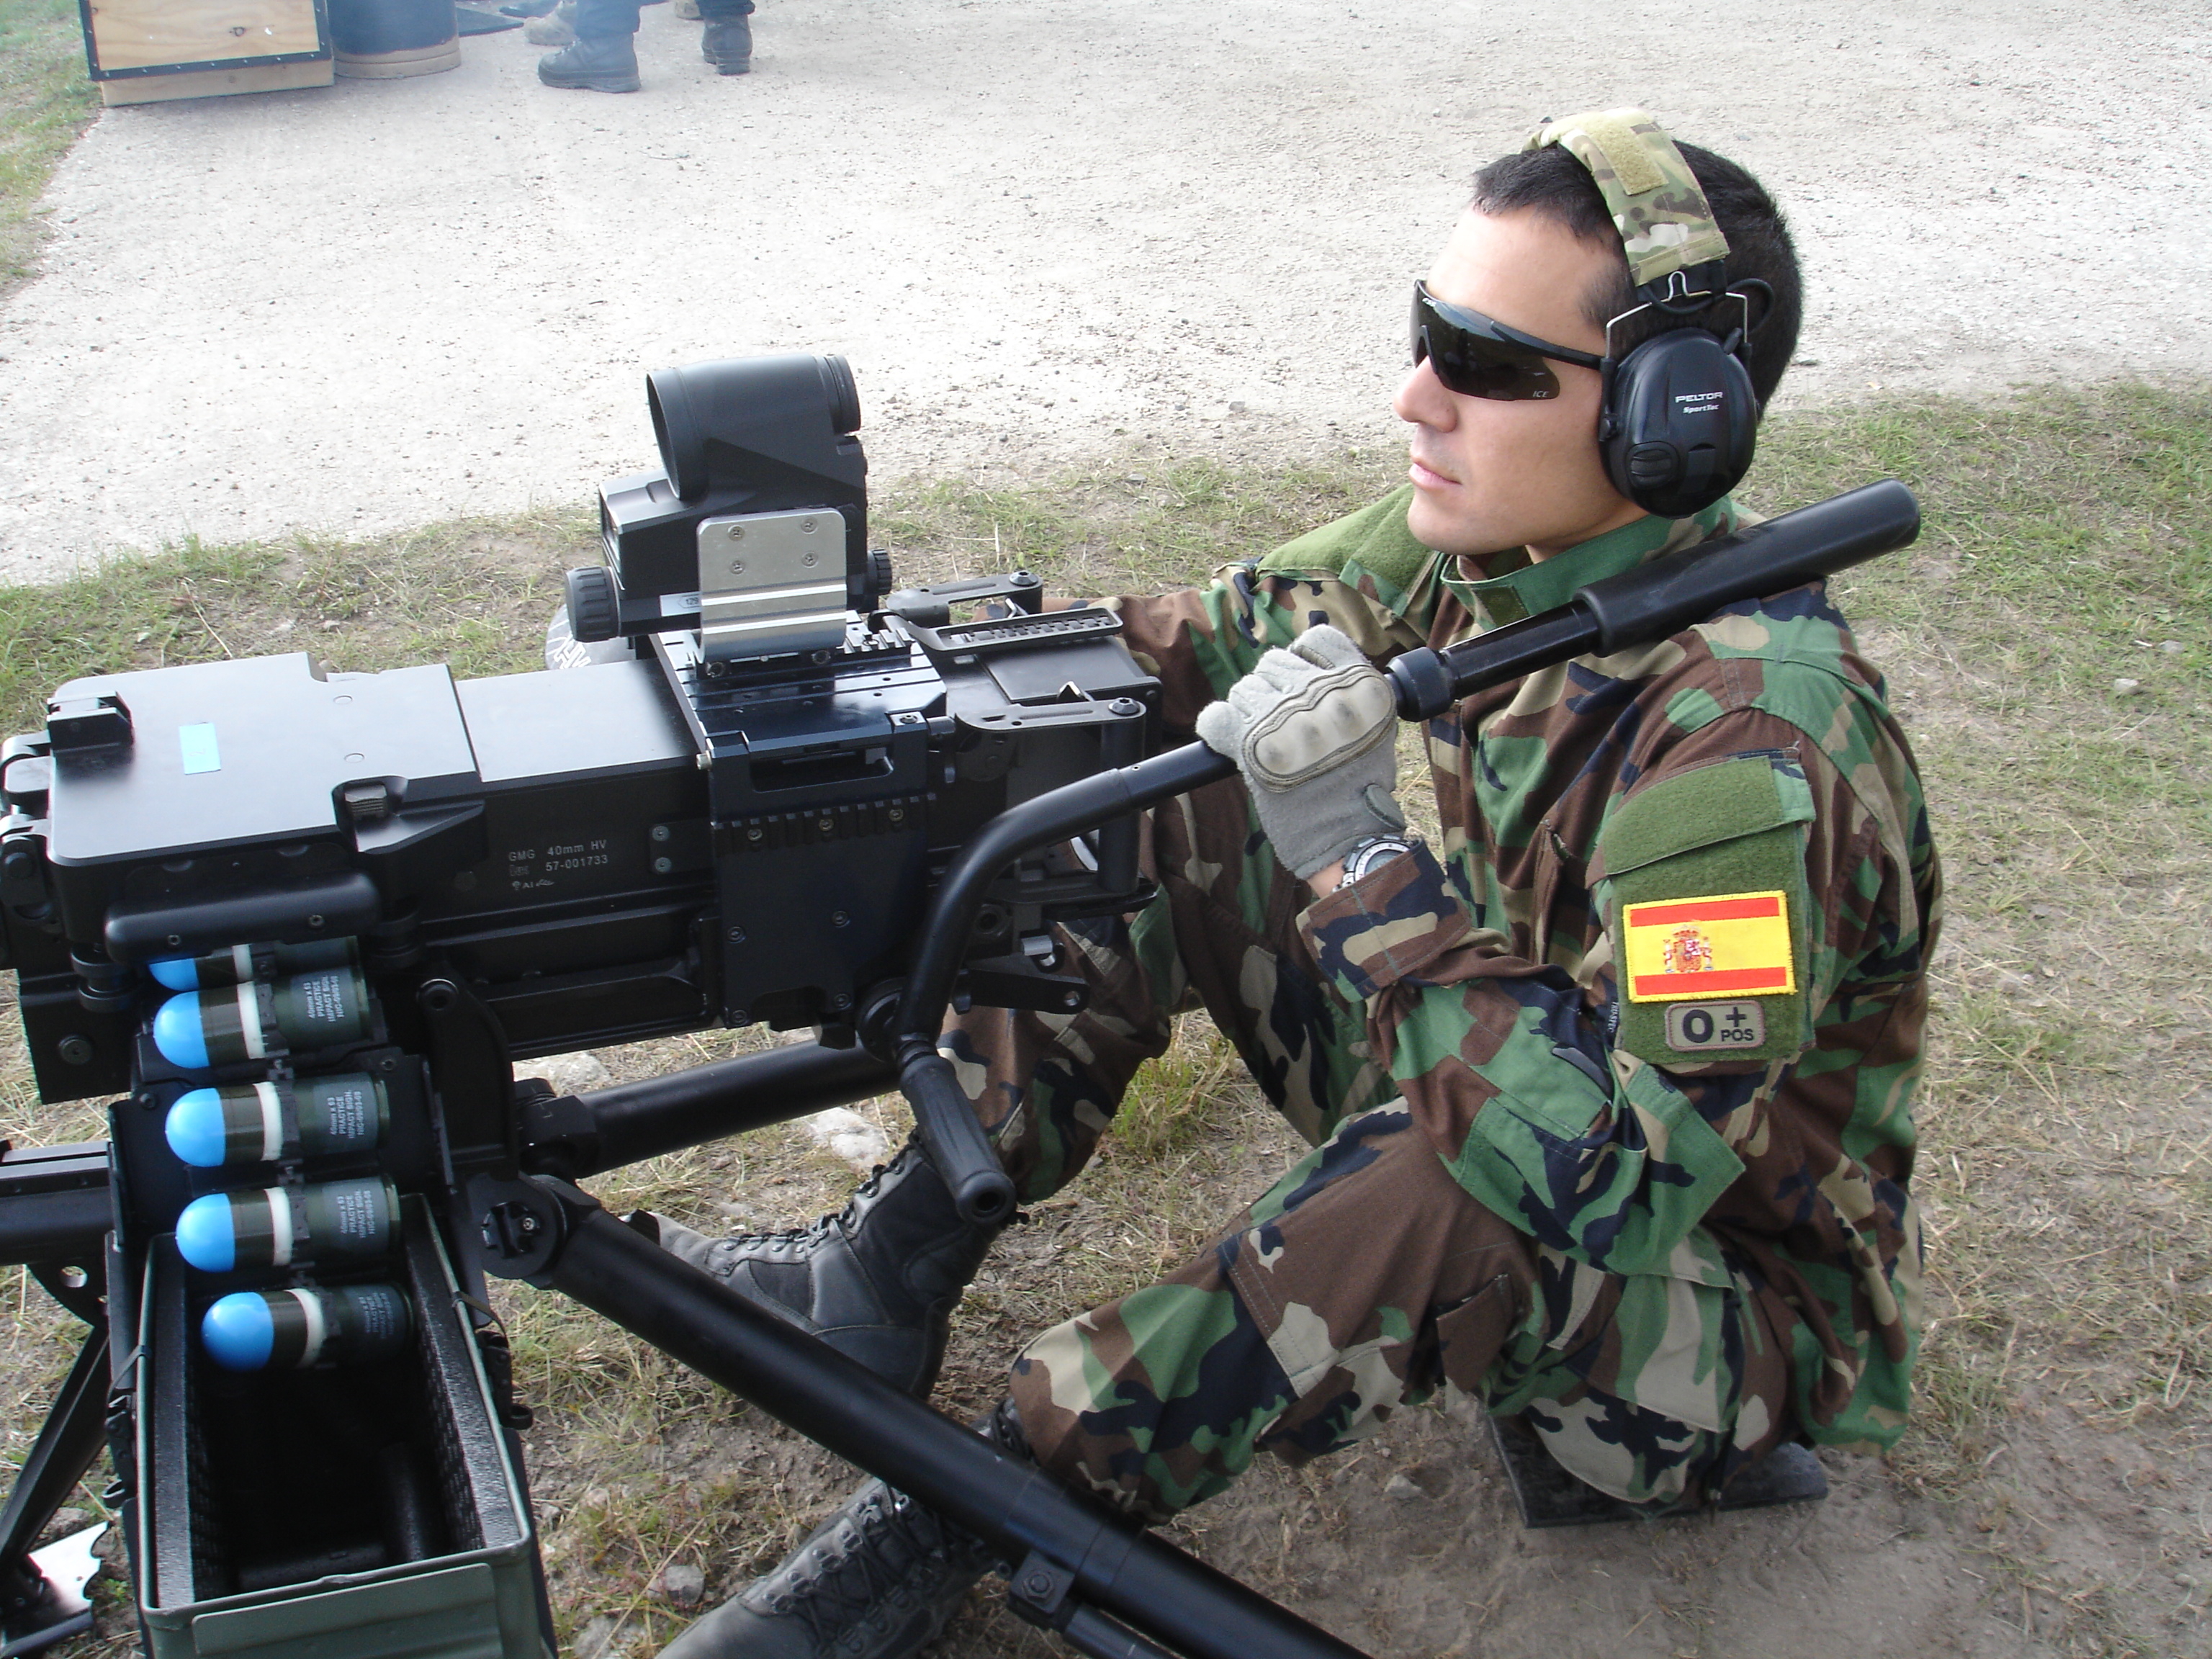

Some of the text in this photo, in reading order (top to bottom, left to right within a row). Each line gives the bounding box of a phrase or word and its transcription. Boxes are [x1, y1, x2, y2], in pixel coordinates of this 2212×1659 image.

[1676, 392, 1723, 403] PELTOR
[1683, 405, 1719, 413] SportTac
[509, 840, 607, 861] GMG 40mm HV
[546, 855, 608, 871] 57-001733
[312, 981, 325, 1017] PRACTICE
[323, 994, 336, 1022] IMPACT
[1720, 1028, 1754, 1041] POS
[336, 1096, 346, 1133] PRACTICE
[346, 1195, 357, 1233] PRACTICE
